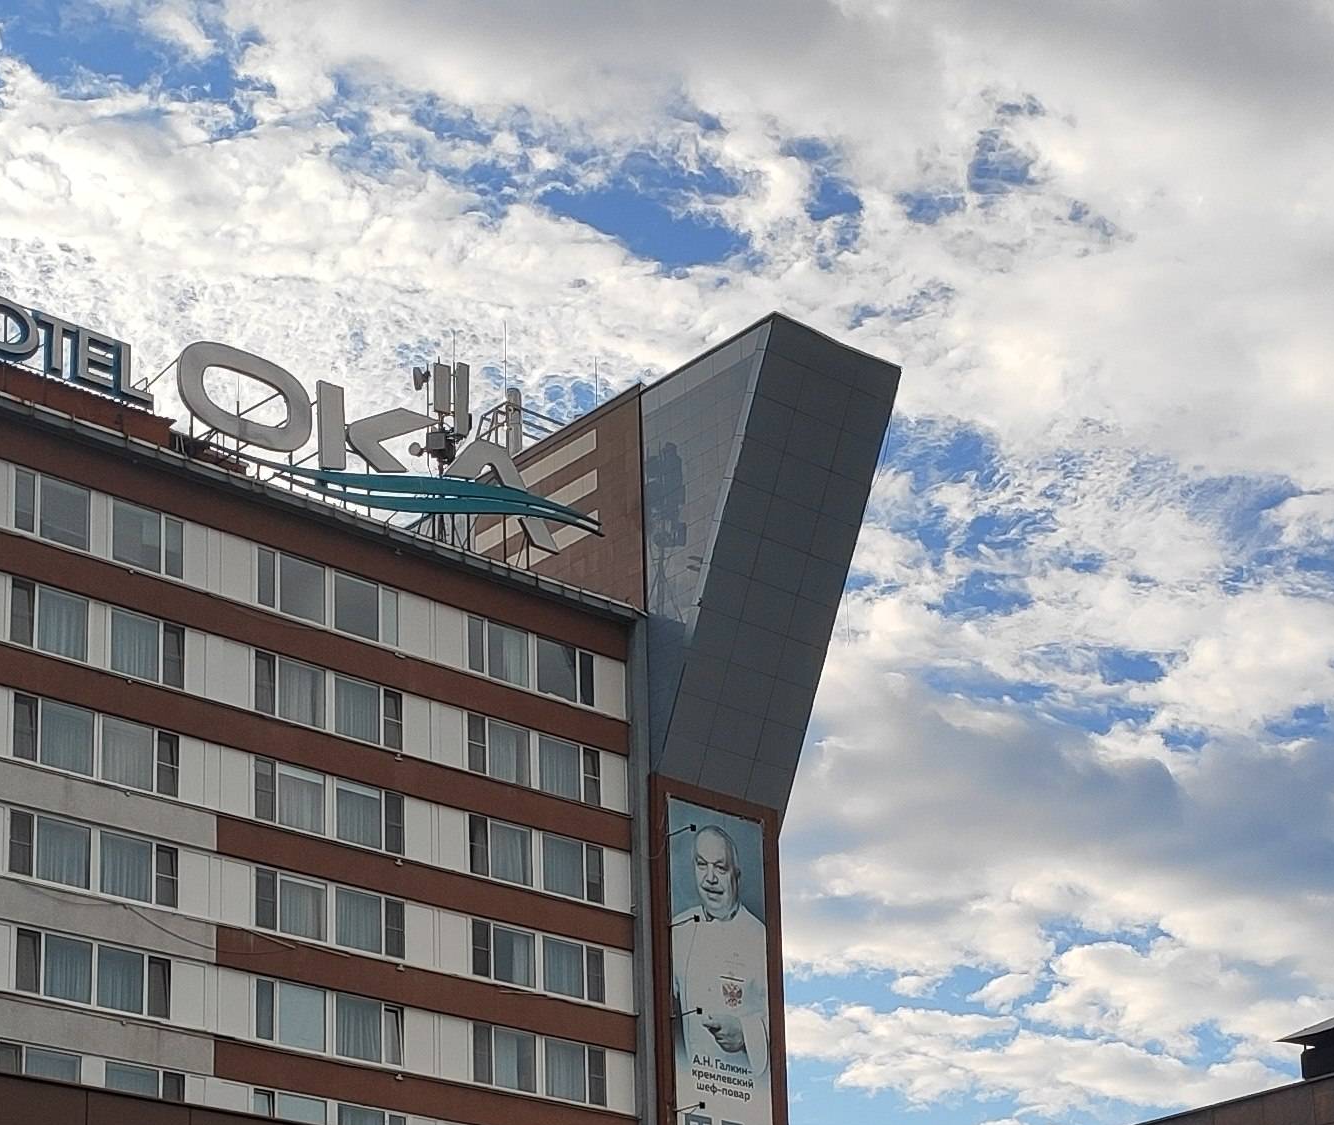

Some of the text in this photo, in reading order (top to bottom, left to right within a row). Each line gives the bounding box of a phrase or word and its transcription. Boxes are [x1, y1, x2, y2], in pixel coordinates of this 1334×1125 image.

[692, 1054, 713, 1068] А.Н.
[691, 1068, 754, 1089] кремлевский
[696, 1081, 751, 1103] шеф-повар
